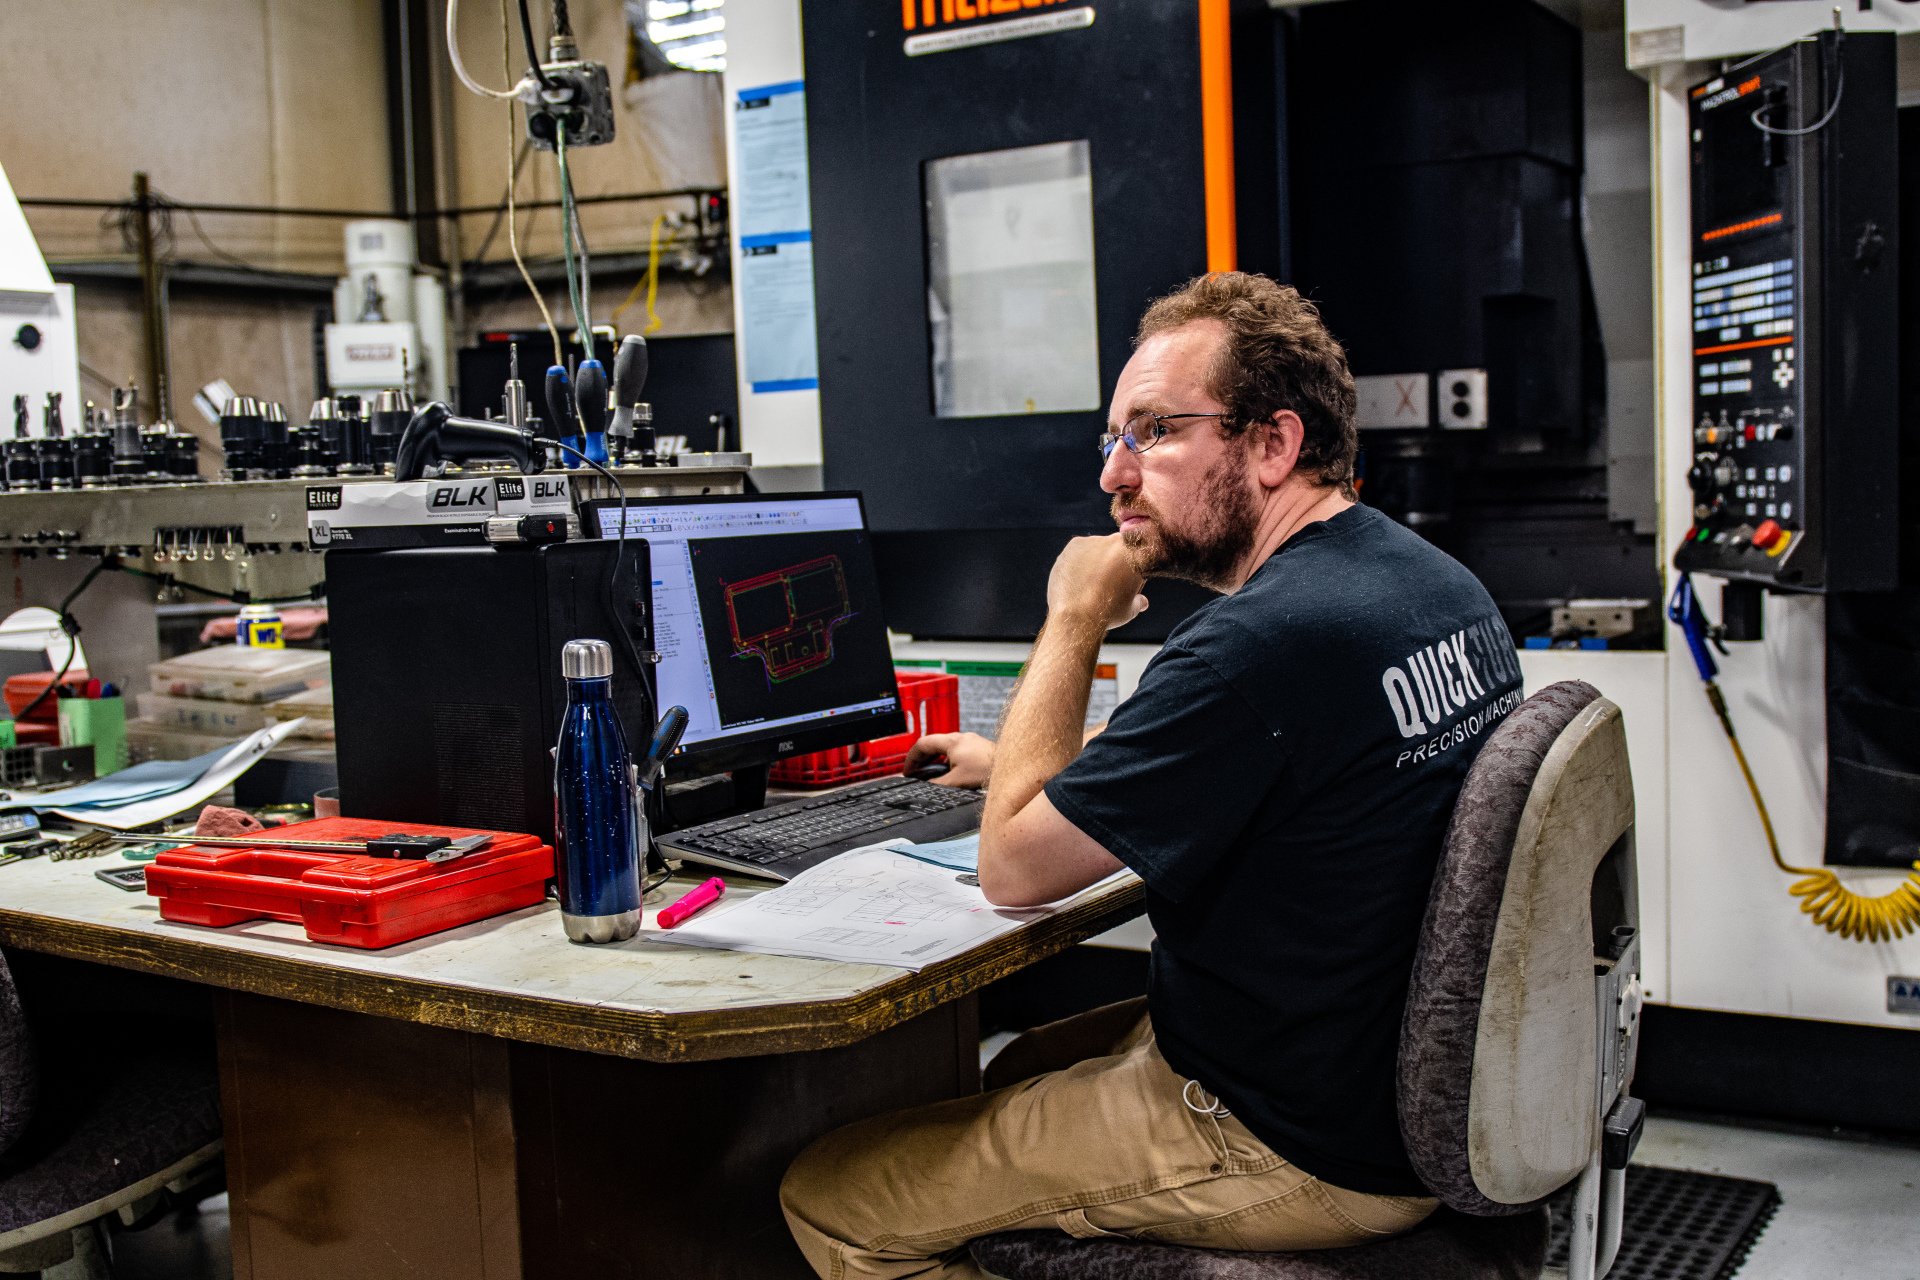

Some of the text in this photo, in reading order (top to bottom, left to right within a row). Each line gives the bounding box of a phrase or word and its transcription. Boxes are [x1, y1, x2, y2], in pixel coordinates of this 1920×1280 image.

[498, 483, 523, 494] Elite
[534, 481, 565, 497] BLK
[309, 491, 340, 503] Elite
[432, 486, 488, 507] BLK
[315, 526, 328, 537] XL
[1396, 710, 1484, 768] PRECISION
